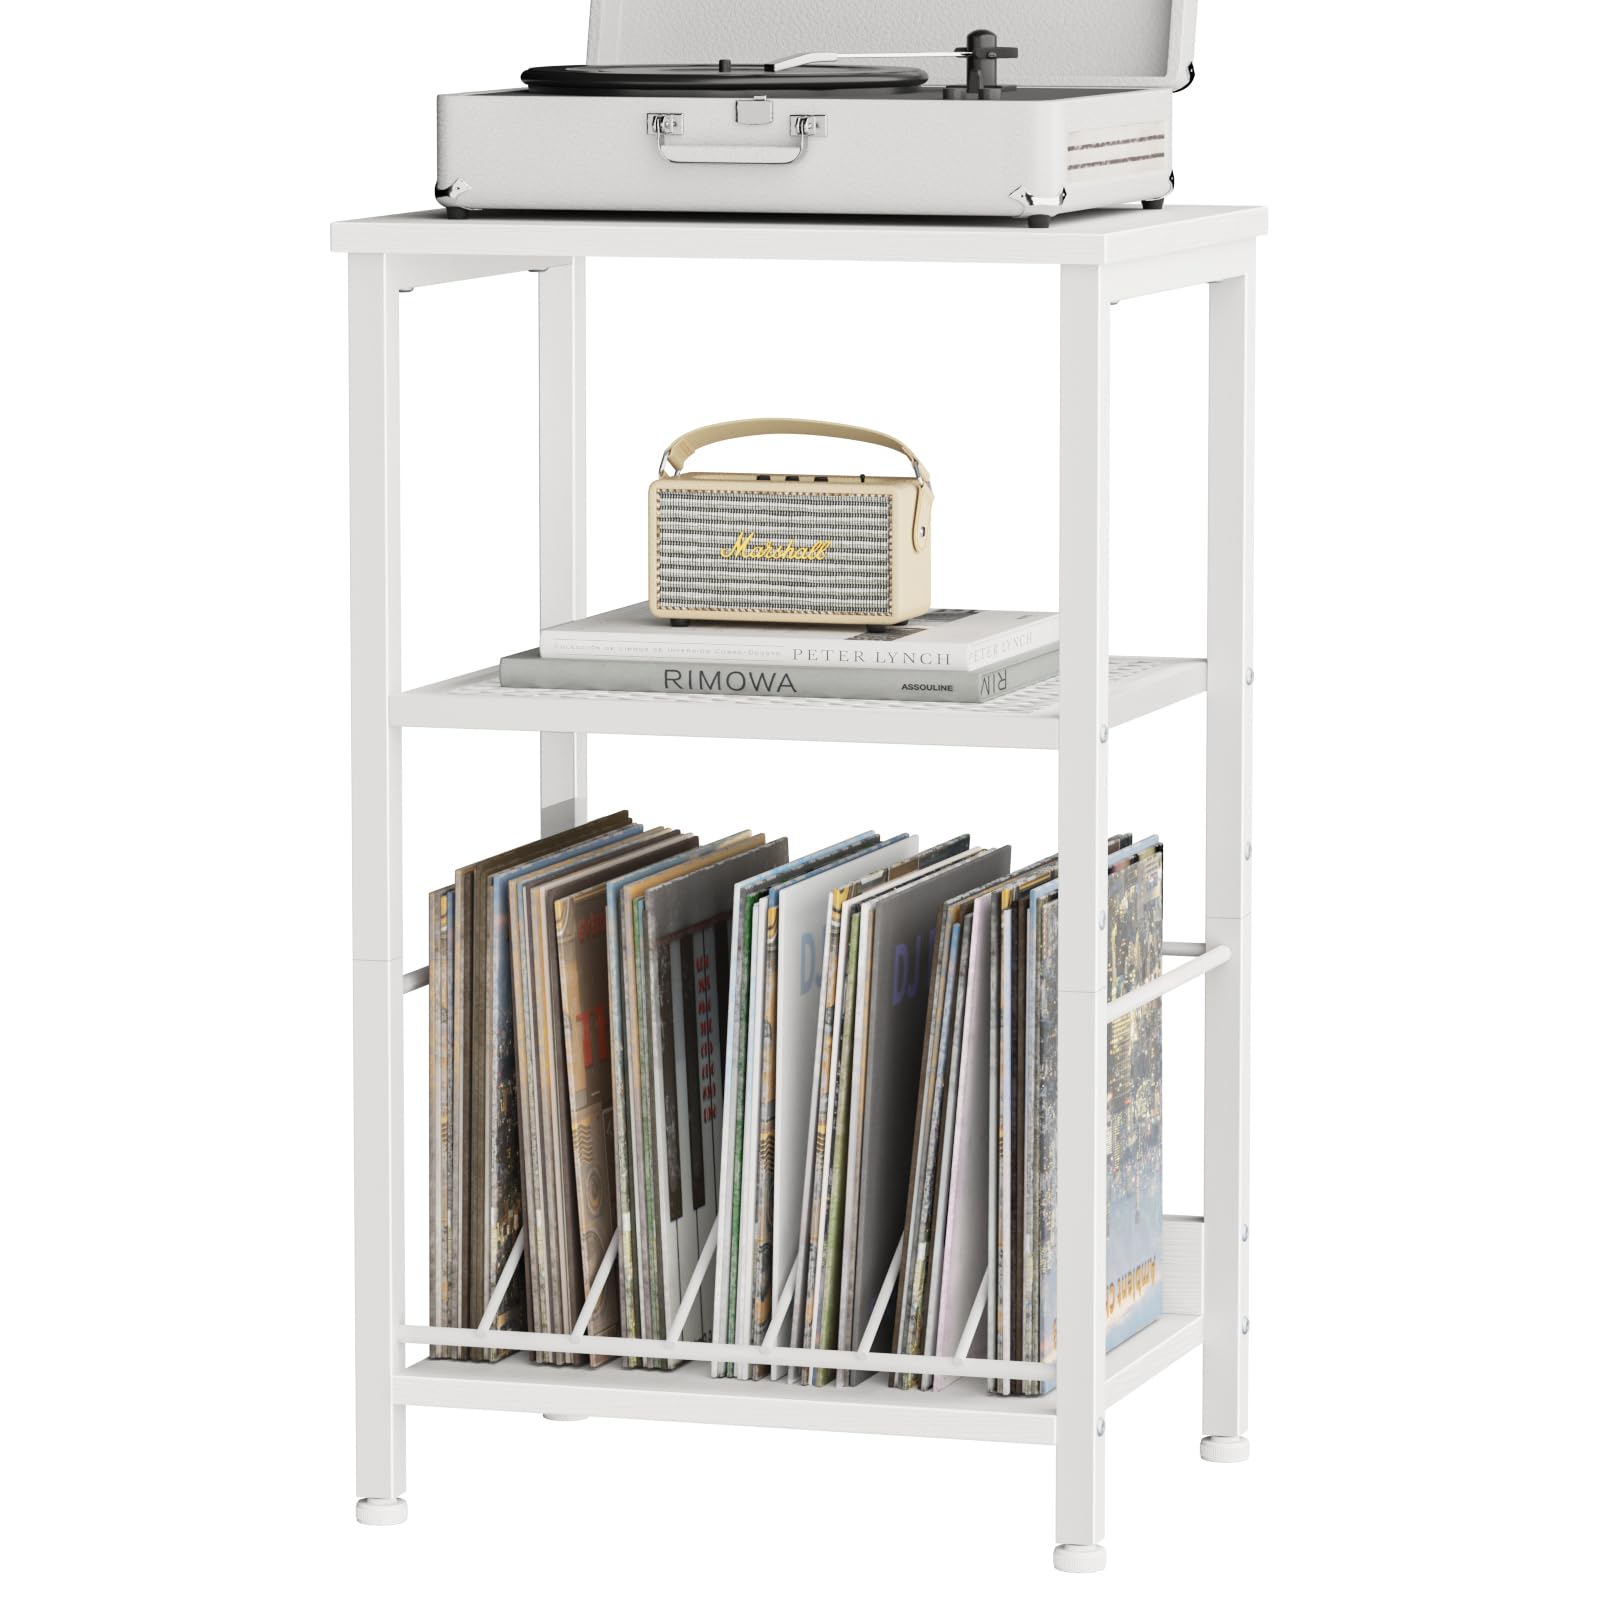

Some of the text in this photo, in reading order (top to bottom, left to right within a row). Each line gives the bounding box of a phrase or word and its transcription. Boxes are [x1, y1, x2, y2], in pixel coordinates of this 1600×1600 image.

[720, 531, 832, 560] Marshall
[793, 648, 865, 663] PETER
[876, 651, 951, 665] LYNCH
[663, 669, 798, 693] RIMOWA
[901, 684, 953, 692] ASSOULINE
